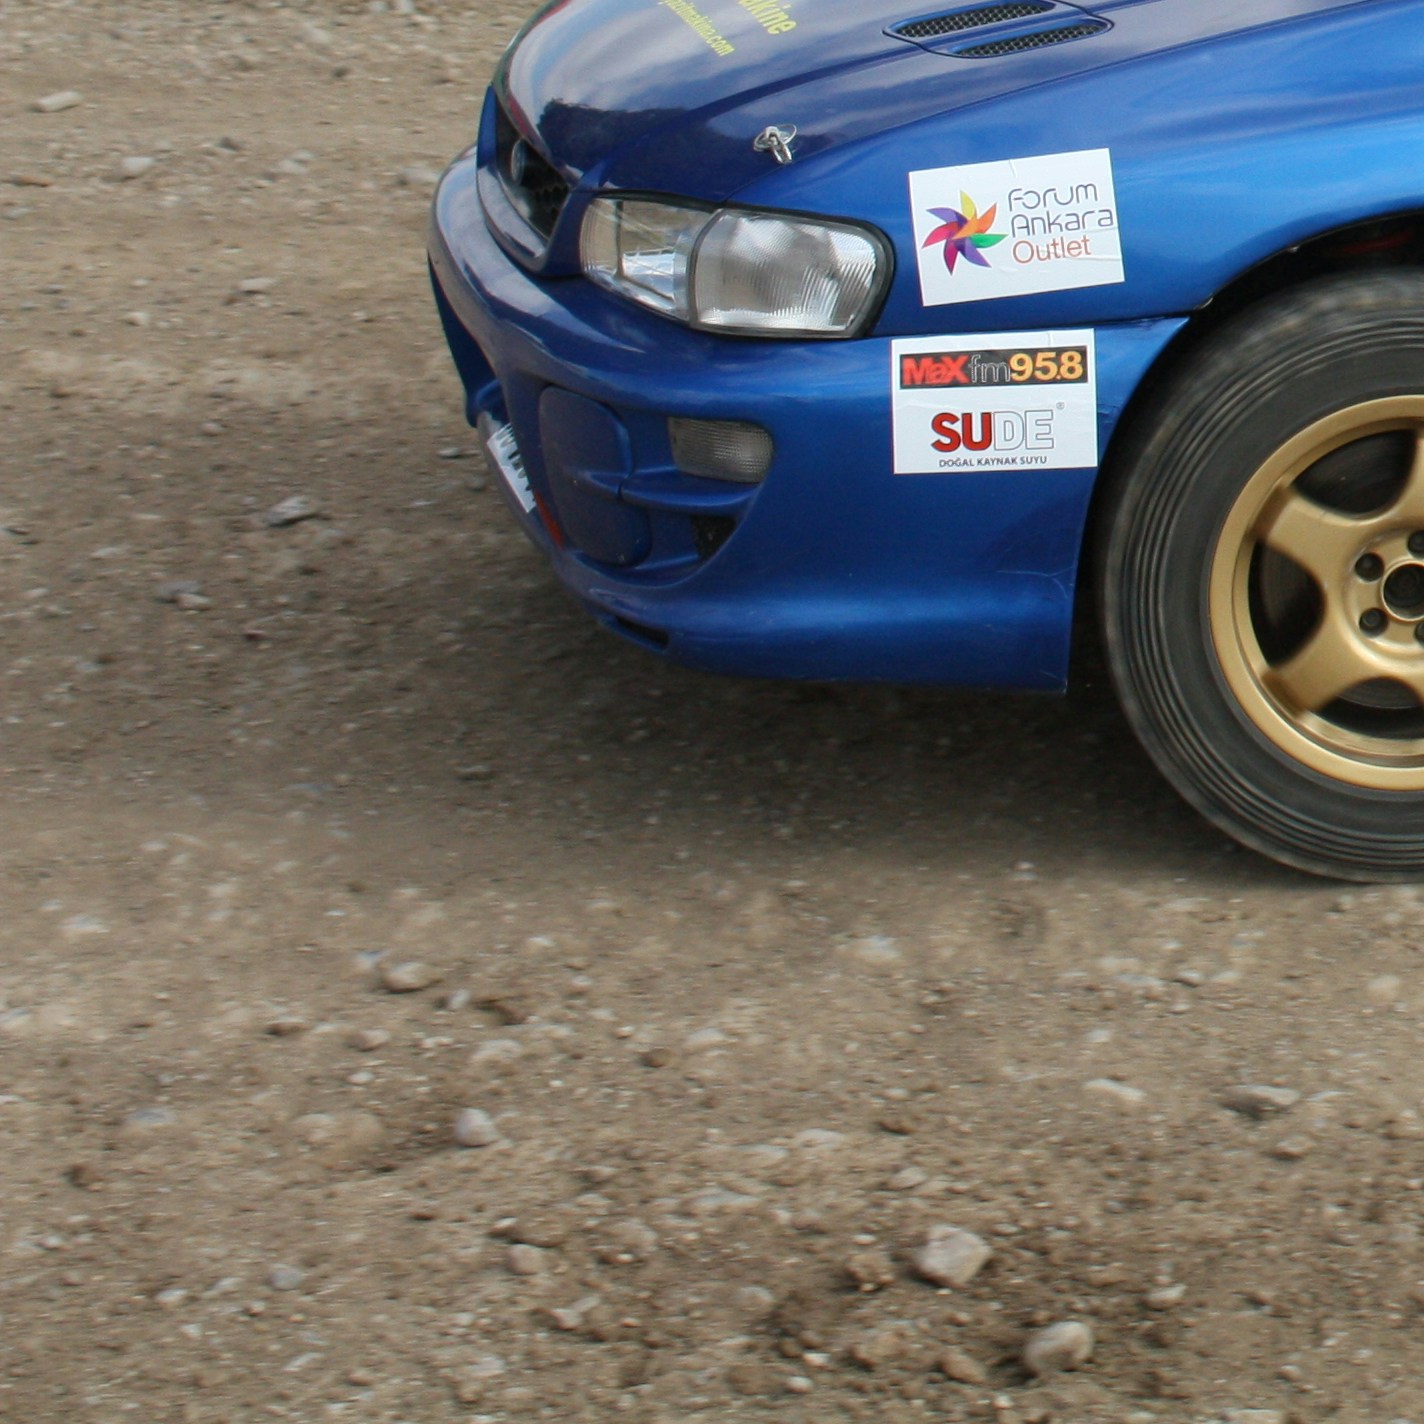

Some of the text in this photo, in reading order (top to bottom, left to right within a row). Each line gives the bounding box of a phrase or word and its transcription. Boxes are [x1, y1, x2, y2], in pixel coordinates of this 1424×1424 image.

[1008, 182, 1098, 212] Forum
[1010, 208, 1114, 239] Ankara
[1012, 234, 1092, 265] Outlet
[930, 408, 1055, 453] SUDE
[938, 454, 1048, 469] DOĞAL KAYNAK SUYU
